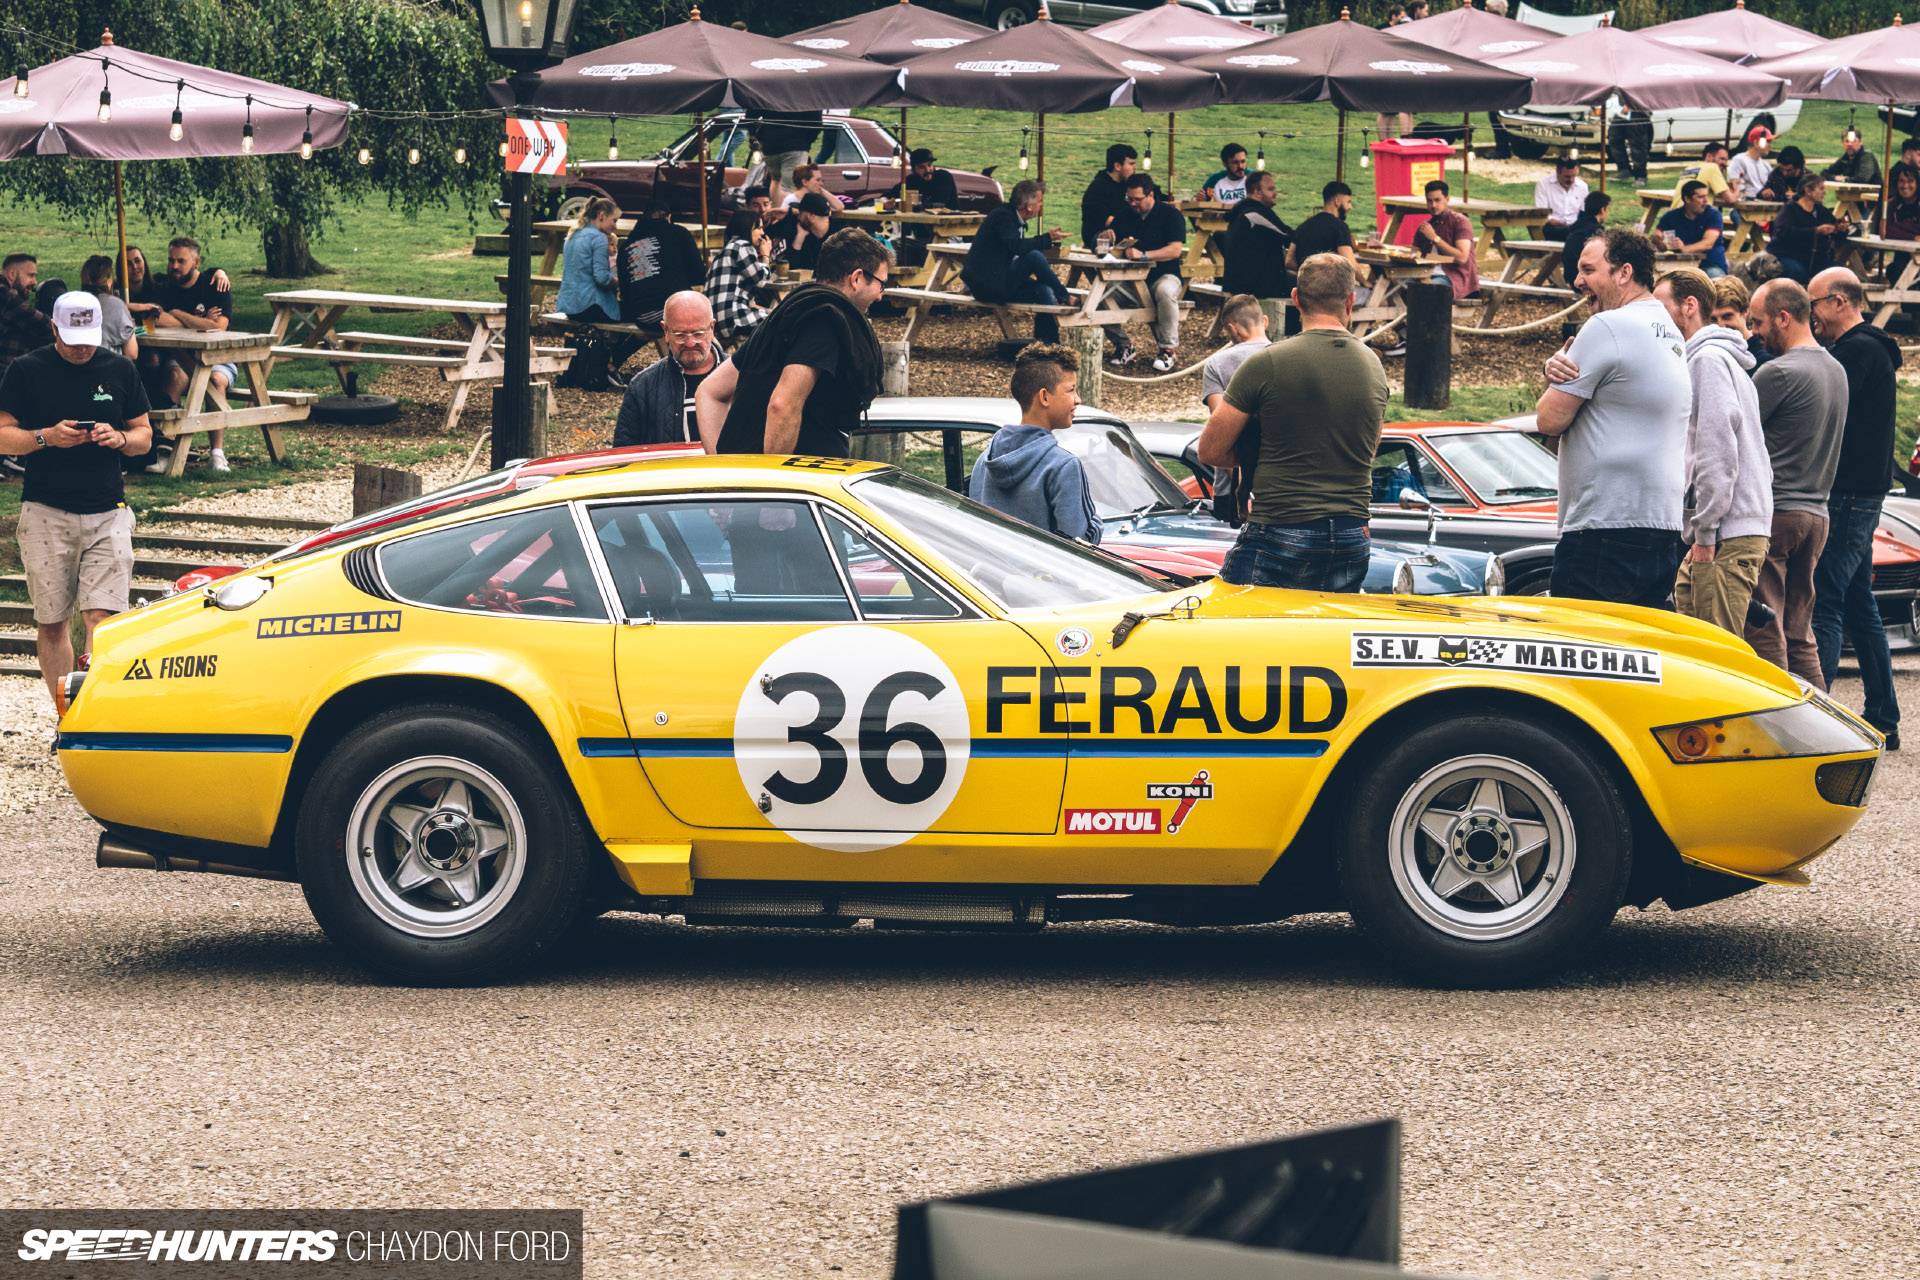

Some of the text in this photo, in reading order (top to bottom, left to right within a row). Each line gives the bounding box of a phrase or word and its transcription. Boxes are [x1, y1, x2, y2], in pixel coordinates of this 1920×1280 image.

[510, 135, 556, 157] ONE WAY
[1219, 187, 1246, 201] VANS
[258, 612, 400, 637] MICHELIN
[159, 654, 219, 679] FISONS
[1356, 637, 1658, 676] S.E.V. MARCHAL
[762, 665, 1348, 805] 36 FERAUD
[1149, 785, 1210, 798] KONI
[1068, 811, 1157, 831] MOTUL
